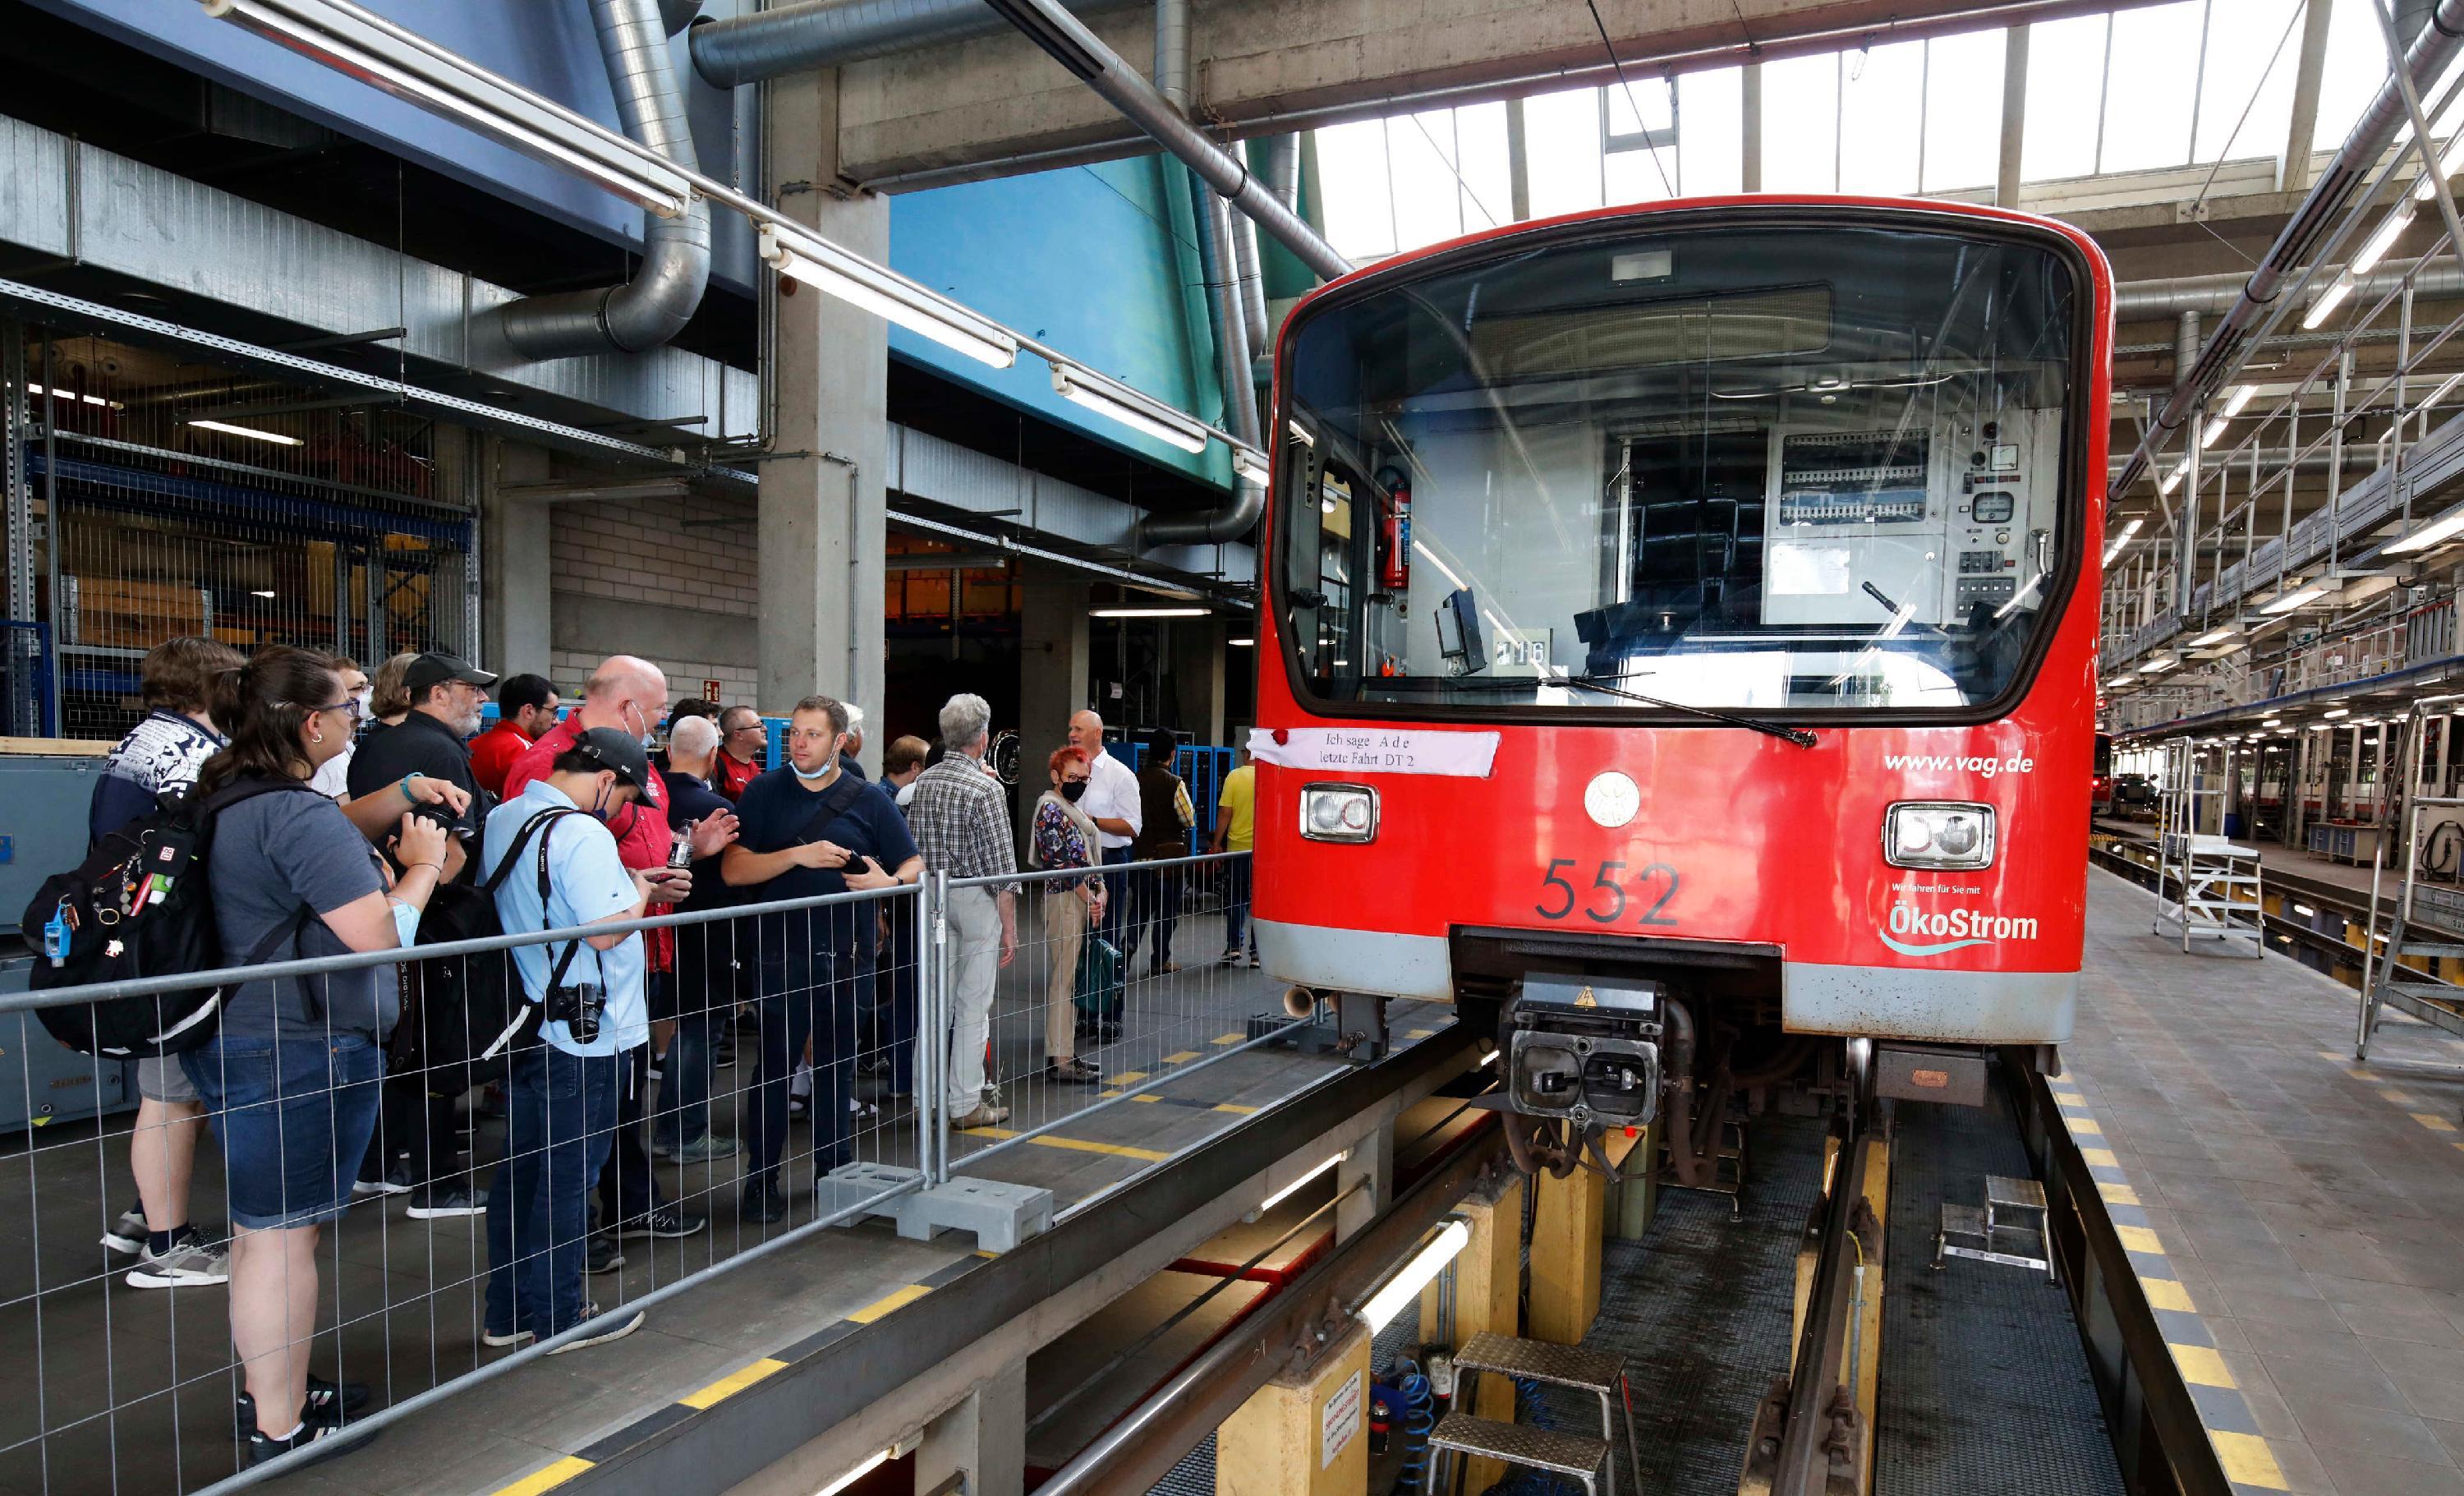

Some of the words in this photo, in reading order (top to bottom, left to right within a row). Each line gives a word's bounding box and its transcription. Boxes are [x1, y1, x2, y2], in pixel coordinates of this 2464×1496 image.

[1326, 733, 1343, 745] Ich
[1346, 737, 1370, 749] sage
[1320, 751, 1348, 763] letzte
[1352, 753, 1378, 765] Fahrt
[1386, 754, 1403, 766] DT
[1407, 756, 1414, 766] 2
[1884, 749, 2034, 779] www.vag.de
[1535, 858, 1680, 927] 552
[1892, 882, 1906, 892] Wir
[1909, 882, 1935, 893] fahren
[1938, 883, 1950, 893] für
[1952, 885, 1964, 894] Sie
[1966, 886, 1981, 895] mit
[1889, 900, 2038, 940] ÖkoStrom
